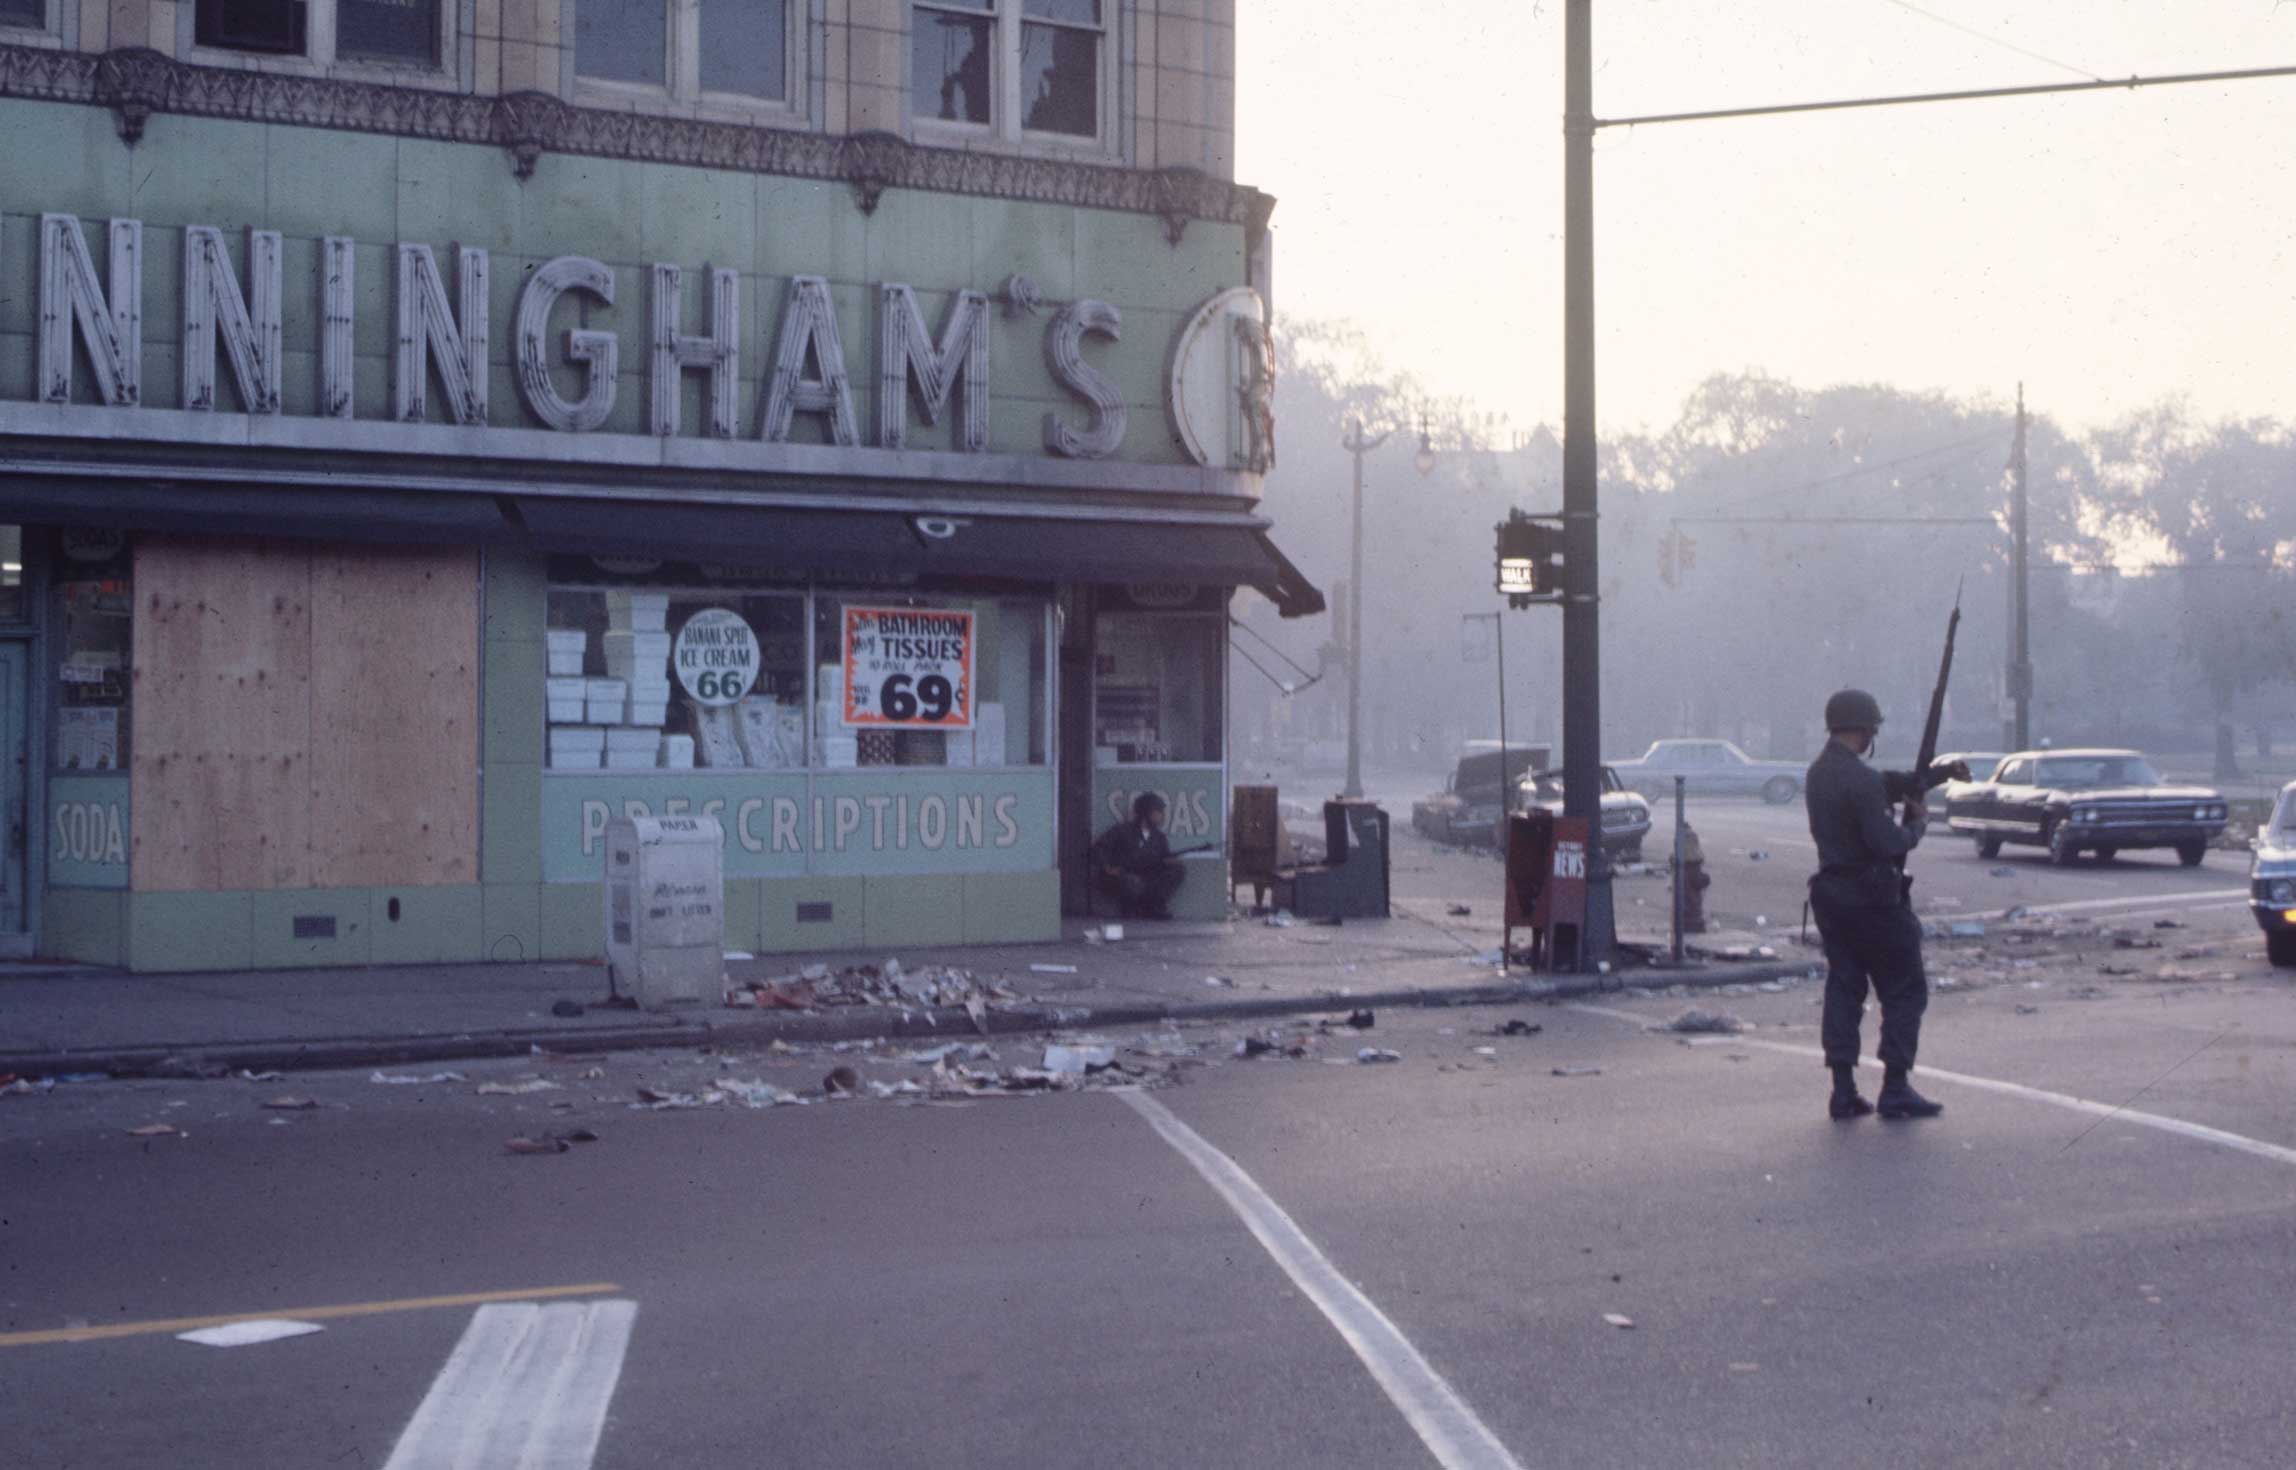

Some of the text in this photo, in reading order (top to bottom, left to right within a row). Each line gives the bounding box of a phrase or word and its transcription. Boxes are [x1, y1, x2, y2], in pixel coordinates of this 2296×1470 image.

[38, 212, 1127, 460] NNINGHAM'S
[1500, 567, 1531, 585] WALK
[684, 625, 748, 645] BANANA SPLIT
[878, 613, 968, 638] BATHROOM
[680, 648, 751, 667] ICE CREAM
[881, 637, 964, 661] TISSUES
[56, 803, 126, 863] SODA
[660, 819, 698, 831] PAPER
[1553, 850, 1586, 879] NEWS
